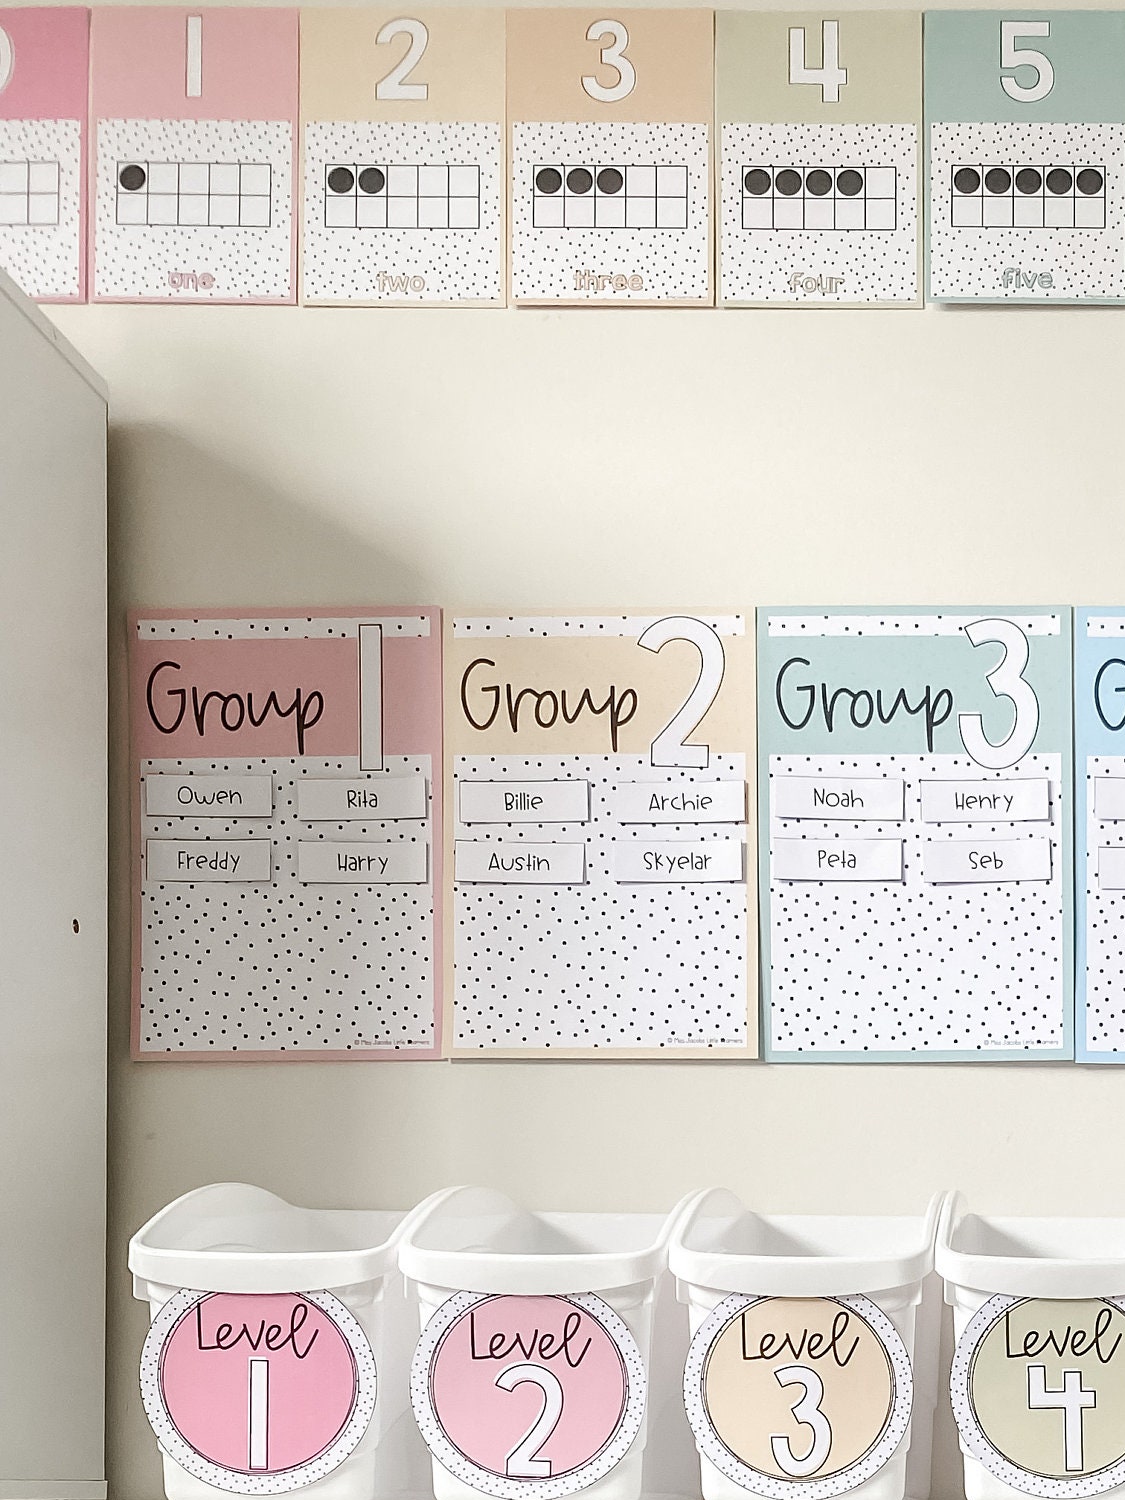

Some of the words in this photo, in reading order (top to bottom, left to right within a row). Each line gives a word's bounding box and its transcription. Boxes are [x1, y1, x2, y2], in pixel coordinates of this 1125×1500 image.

[185, 15, 202, 98] 1
[375, 18, 430, 100] 2
[581, 20, 636, 102] 3
[789, 20, 847, 103] 4
[1000, 20, 1055, 103] 5
[168, 271, 216, 290] one
[376, 271, 426, 293] two
[574, 271, 644, 292] three
[789, 272, 846, 294] four
[1002, 267, 1054, 290] five
[146, 661, 324, 756] Group
[358, 623, 383, 772] 1
[461, 659, 637, 752] Group
[637, 615, 726, 769] 2
[776, 657, 953, 753] Group
[958, 617, 1040, 770] 3
[177, 785, 243, 806] Owen
[346, 789, 379, 810] Rita
[504, 792, 543, 812] Billie
[648, 792, 713, 812] Archie
[813, 789, 865, 809] Noah
[954, 791, 1014, 813] Henry
[177, 850, 240, 873] Freddy
[337, 853, 389, 875] Harry
[488, 853, 551, 873] Austin
[642, 852, 713, 873] Skyelar
[817, 851, 858, 871] Peta
[968, 851, 1005, 871] Seb
[196, 1302, 319, 1360] Level
[468, 1311, 592, 1368] Level
[740, 1311, 860, 1368] Level
[1004, 1308, 1123, 1364] Level
[248, 1358, 270, 1470] 1
[495, 1363, 565, 1478] 2
[770, 1365, 833, 1478] 3
[1026, 1364, 1097, 1472] 4
